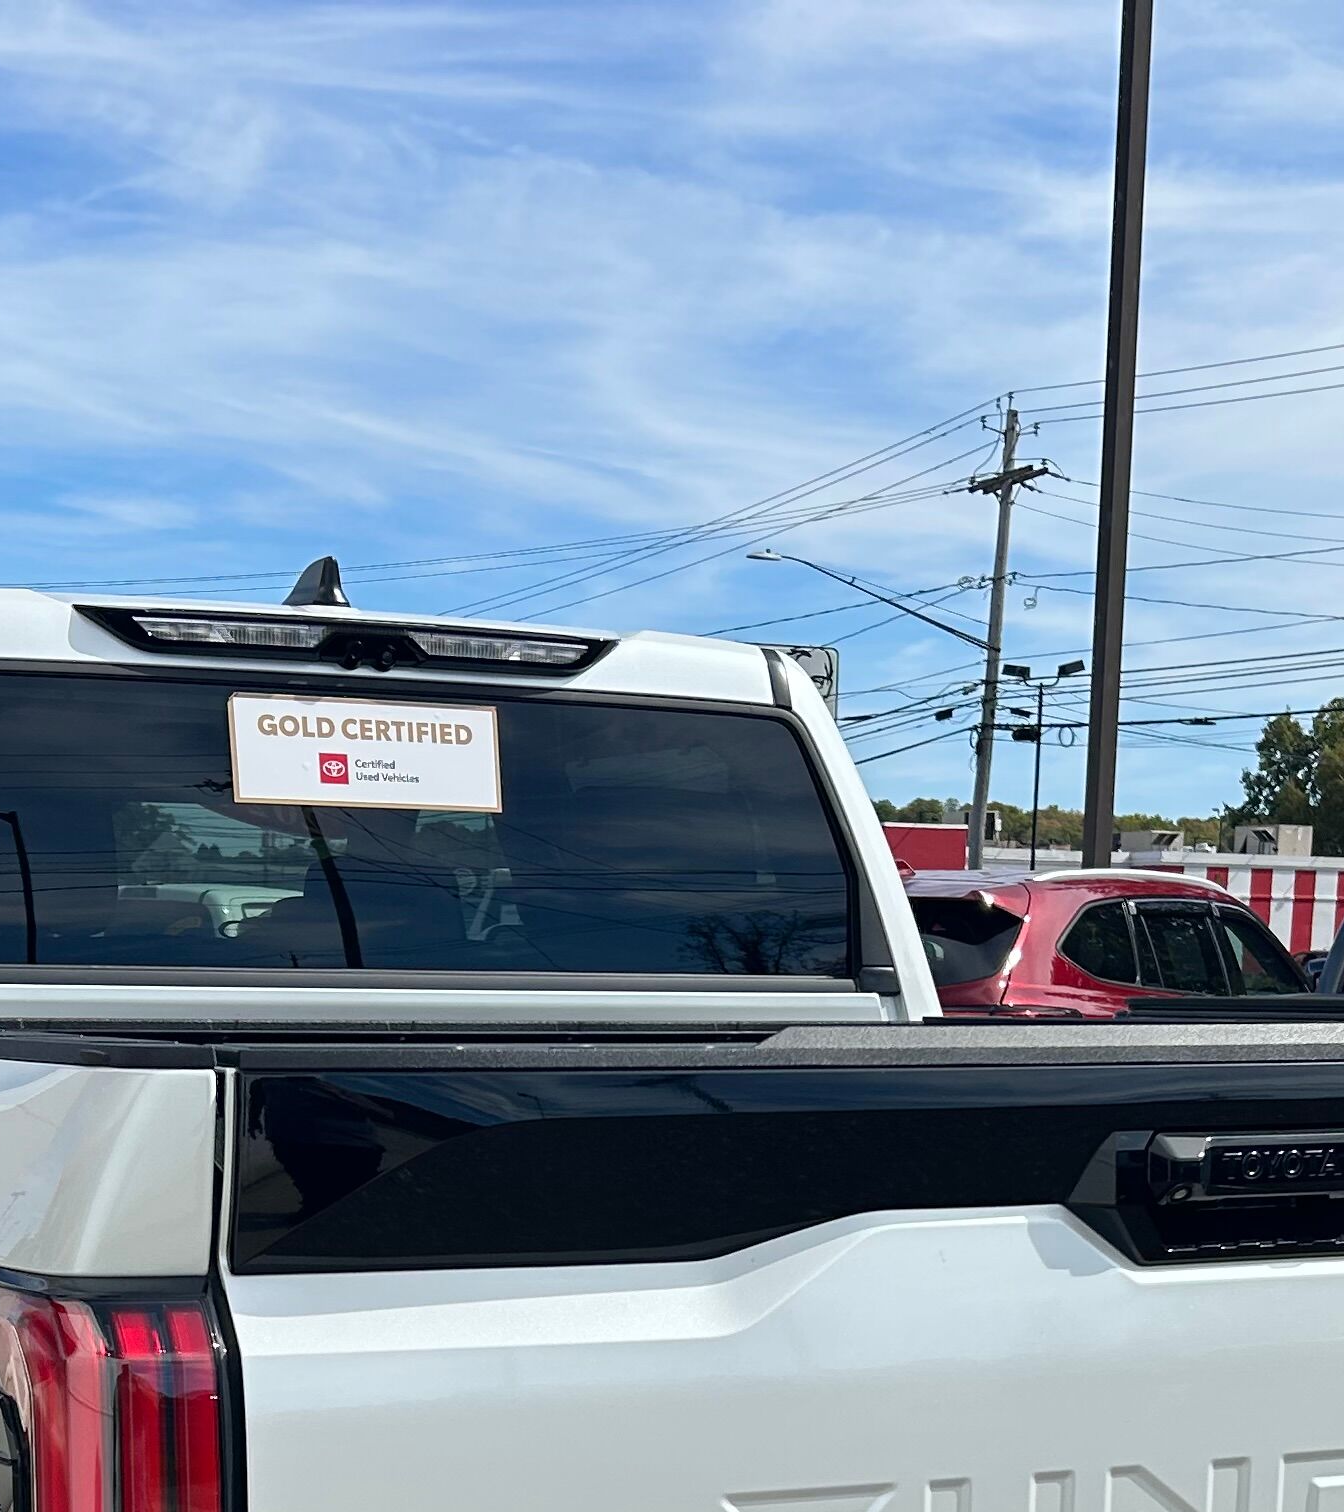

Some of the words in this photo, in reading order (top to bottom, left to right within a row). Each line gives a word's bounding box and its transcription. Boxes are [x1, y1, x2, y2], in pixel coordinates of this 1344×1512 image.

[257, 713, 335, 739] GOLD
[341, 718, 473, 746] CERTIFIED
[354, 758, 396, 771] Certified
[355, 771, 380, 783] Used
[381, 772, 420, 784] Vehicles
[1222, 1148, 1343, 1179] TOYOTA
